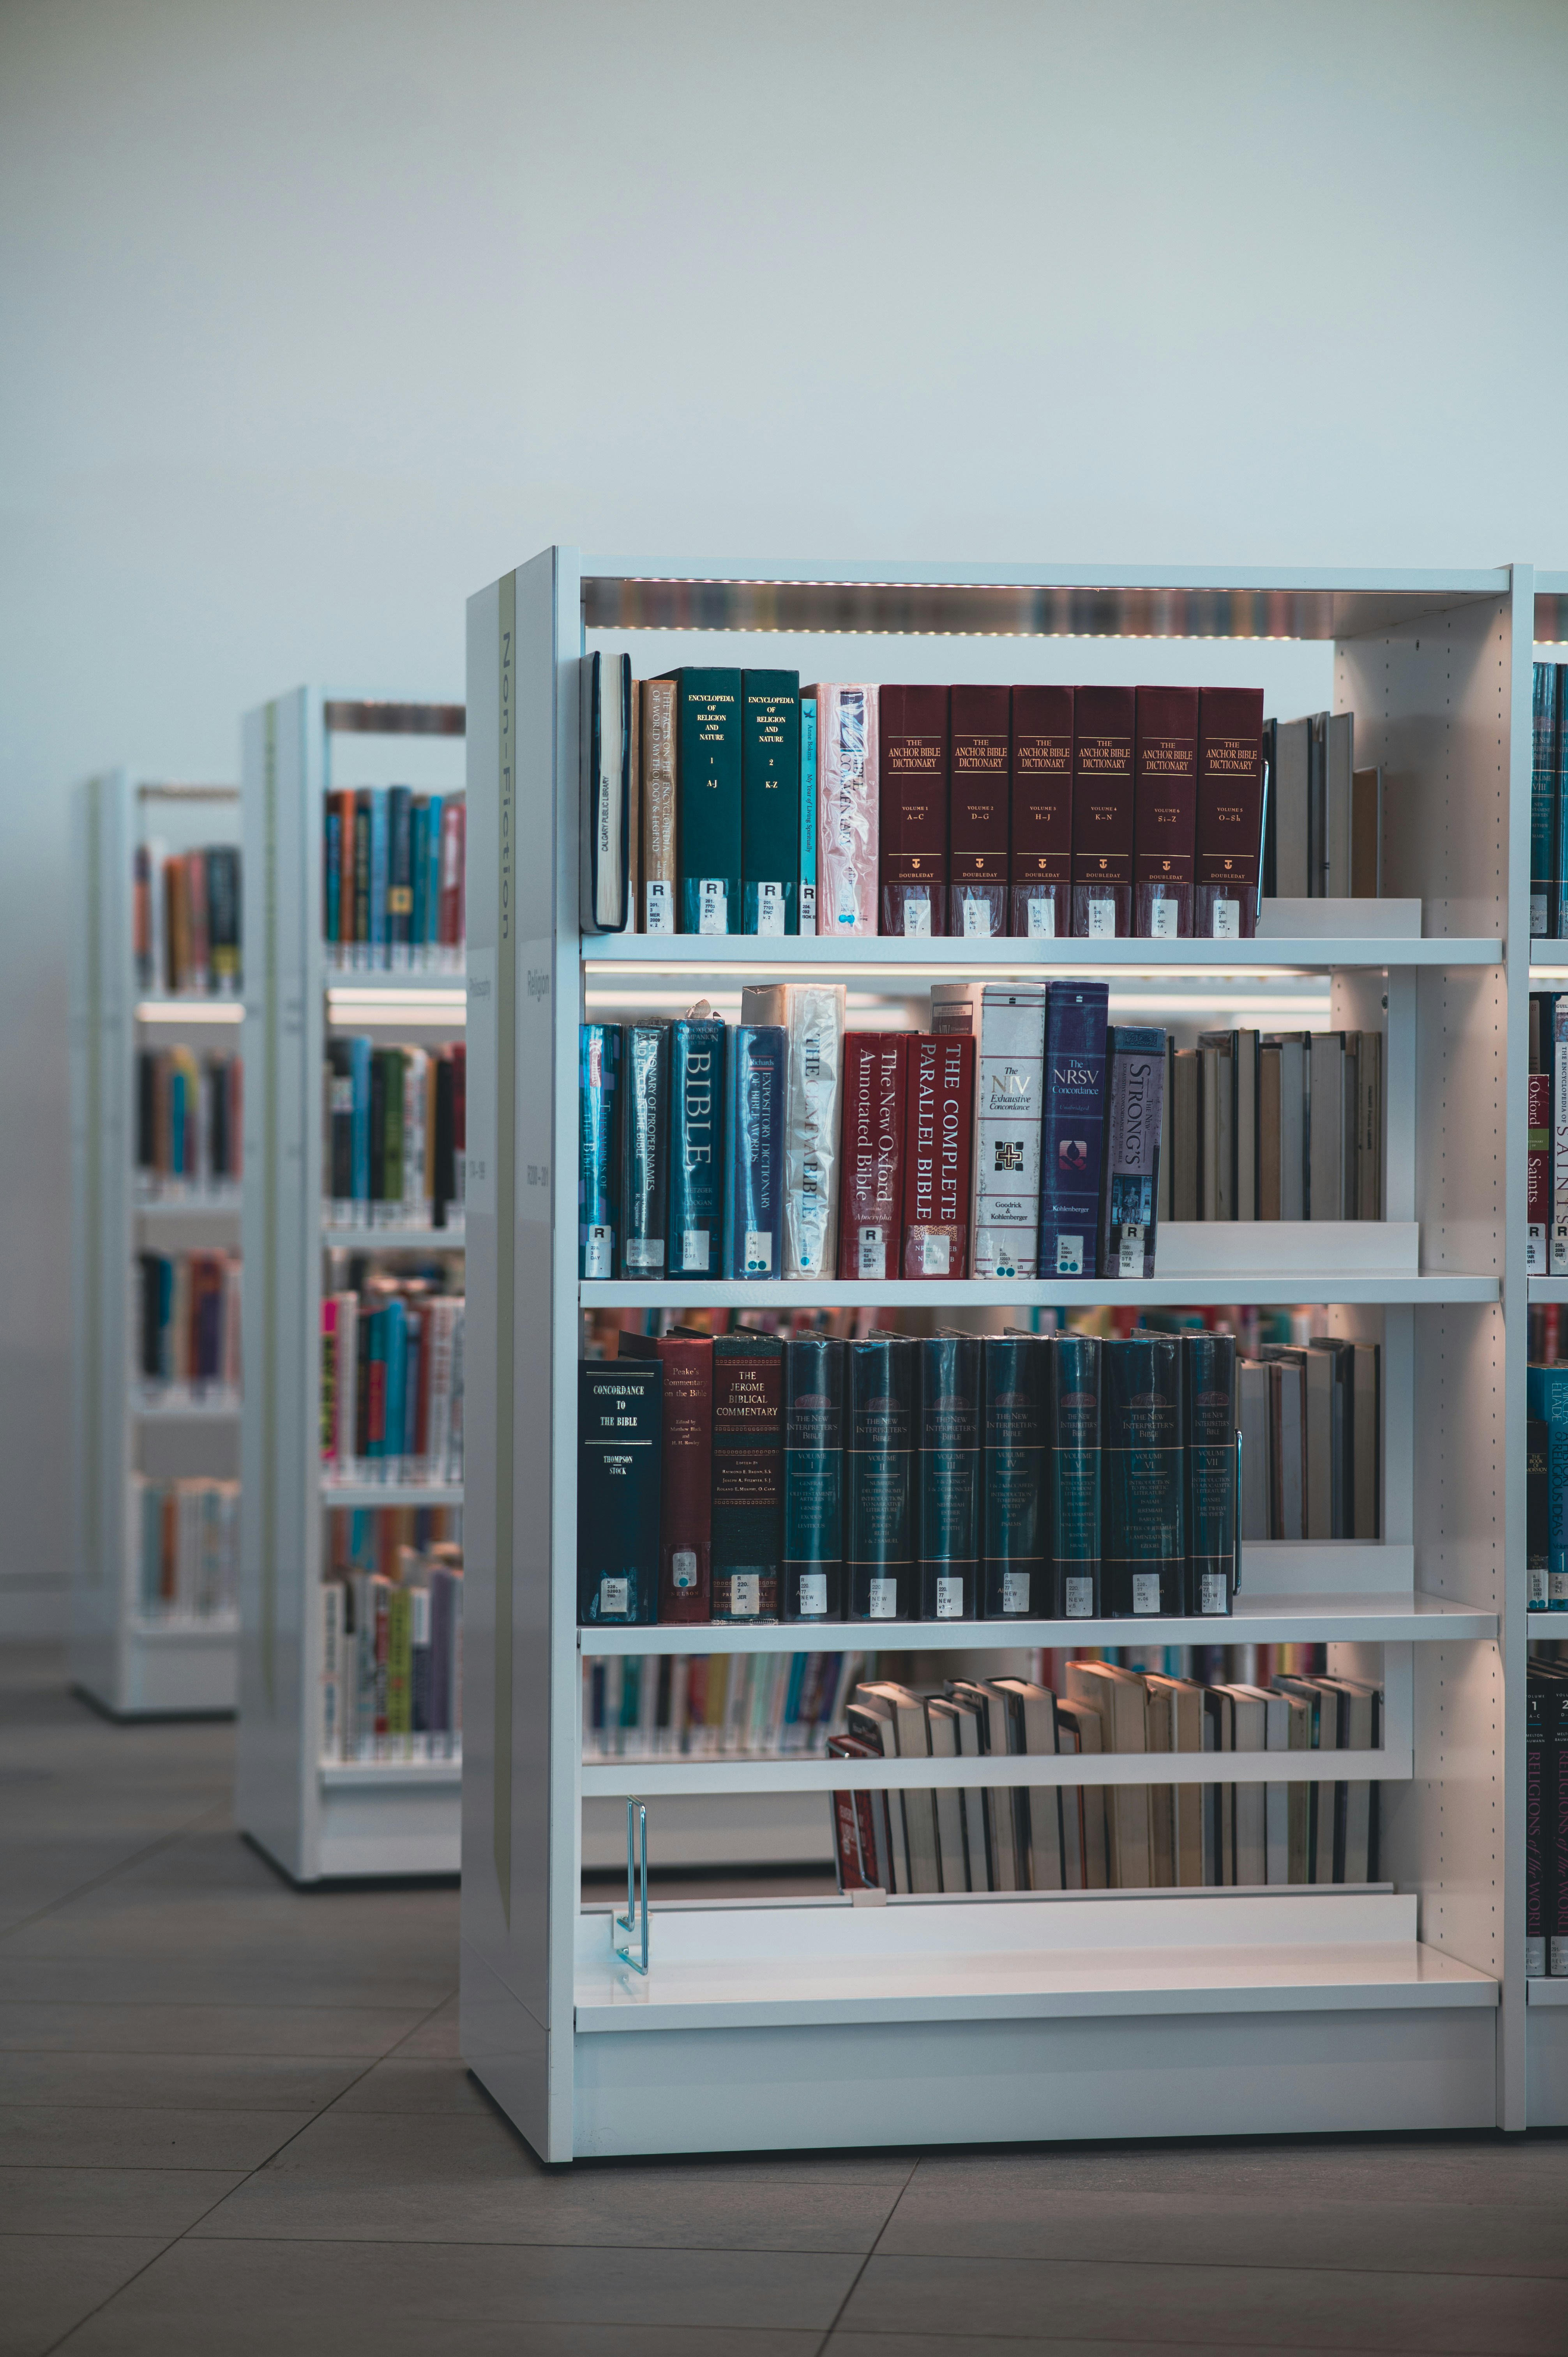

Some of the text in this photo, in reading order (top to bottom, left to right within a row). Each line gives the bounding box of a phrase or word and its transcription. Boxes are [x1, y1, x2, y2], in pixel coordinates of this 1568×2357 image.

[652, 690, 660, 702] OF
[663, 742, 670, 756] ON
[888, 747, 940, 756] ANCHOR BIBLE
[1018, 748, 1070, 757] ANCHOR BIBLE
[893, 759, 936, 768] DICTIONARY
[1022, 759, 1065, 768] DICTIONARY
[806, 774, 812, 783] My
[653, 885, 664, 895] R
[804, 889, 814, 898] R
[528, 969, 549, 1002] Religion
[638, 1033, 646, 1056] AND
[945, 1044, 961, 1088] THE
[1069, 1060, 1083, 1068] The
[637, 1059, 646, 1096] PLACES
[752, 1072, 760, 1084] OF
[1054, 1069, 1099, 1084] NRSV
[992, 1076, 1030, 1094] NIV
[1052, 1086, 1098, 1095] Concordance
[637, 1098, 645, 1109] IN
[991, 1095, 1031, 1103] Exhaustive
[1529, 1081, 1540, 1125] Oxford
[646, 1034, 658, 1191] DICTIONARY OF PROPER NAMES
[685, 1051, 711, 1164] BIBLE
[803, 1034, 819, 1219] THE GENEVA BIBLE
[856, 1048, 876, 1201] Annotated Bible
[877, 1050, 897, 1201] The New Oxford
[916, 1043, 936, 1219] PARALLEL BIBLE
[636, 1133, 644, 1159] BIBLE
[761, 1072, 771, 1209] EXPOSITORY DICTIONARY
[941, 1099, 959, 1220] COMPLETE
[1529, 1158, 1541, 1203] Saints
[855, 1213, 892, 1221] Apocrypha
[595, 1228, 604, 1237] R
[866, 1230, 876, 1240] R
[1127, 1227, 1137, 1236] R
[739, 1372, 756, 1380] THE
[664, 1379, 708, 1387] Commentary
[731, 1383, 765, 1391] JEROME
[593, 1386, 645, 1395] CONCORDANCE
[729, 1395, 768, 1403] BIBLICAL
[1552, 1383, 1562, 1422] ELIADE
[616, 1401, 626, 1409] TO
[717, 1408, 778, 1416] COMMENTARY
[600, 1417, 637, 1426] THE BIBLE
[1528, 1752, 1540, 1835] RELIGIONS
